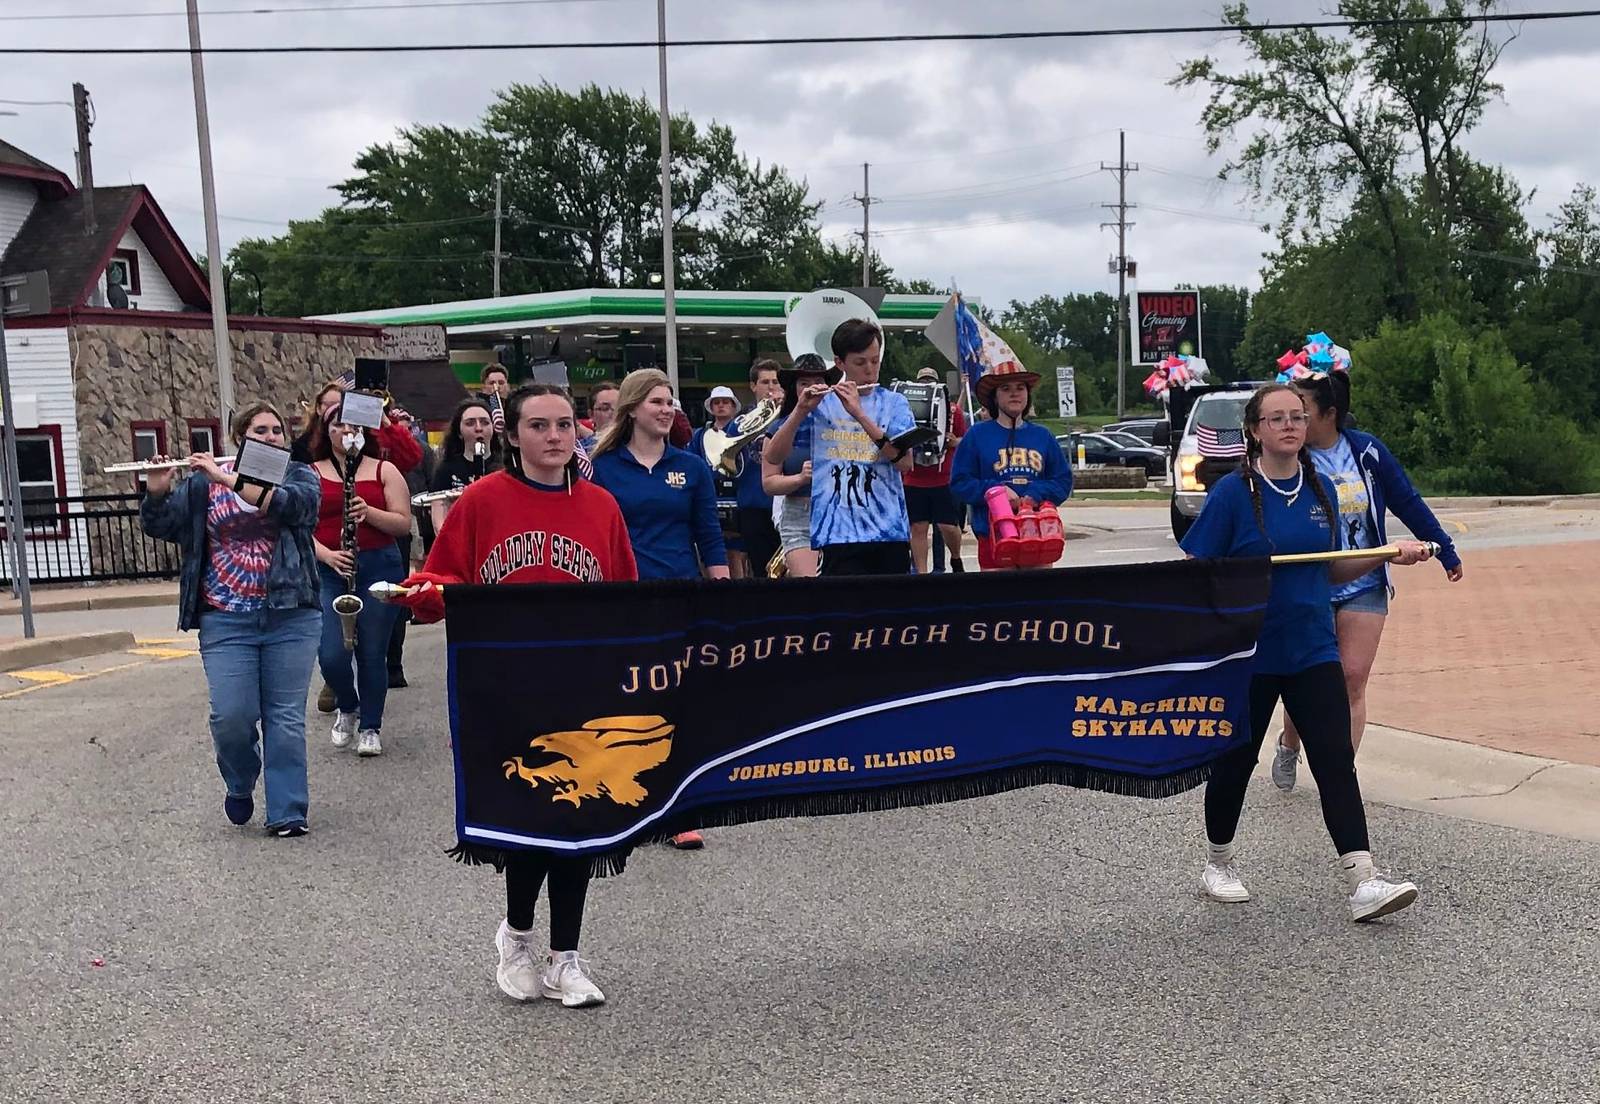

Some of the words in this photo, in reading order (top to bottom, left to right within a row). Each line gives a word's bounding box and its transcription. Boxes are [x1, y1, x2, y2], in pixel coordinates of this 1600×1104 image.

[1141, 295, 1195, 316] VIDEO
[1141, 311, 1187, 332] Gaming
[1143, 352, 1158, 360] PLAY
[993, 447, 1042, 472] JHS
[665, 471, 687, 485] JHS
[480, 531, 546, 584] HOLIDAY
[551, 533, 603, 582] SEASO
[852, 624, 949, 650] HIGH
[968, 620, 1121, 650] SCHOOL
[1074, 695, 1225, 716] MARCHING
[1071, 718, 1233, 737] SKYHAWKS
[728, 756, 855, 782] JOHNSBURG,
[863, 745, 956, 769] ILLINOIS
